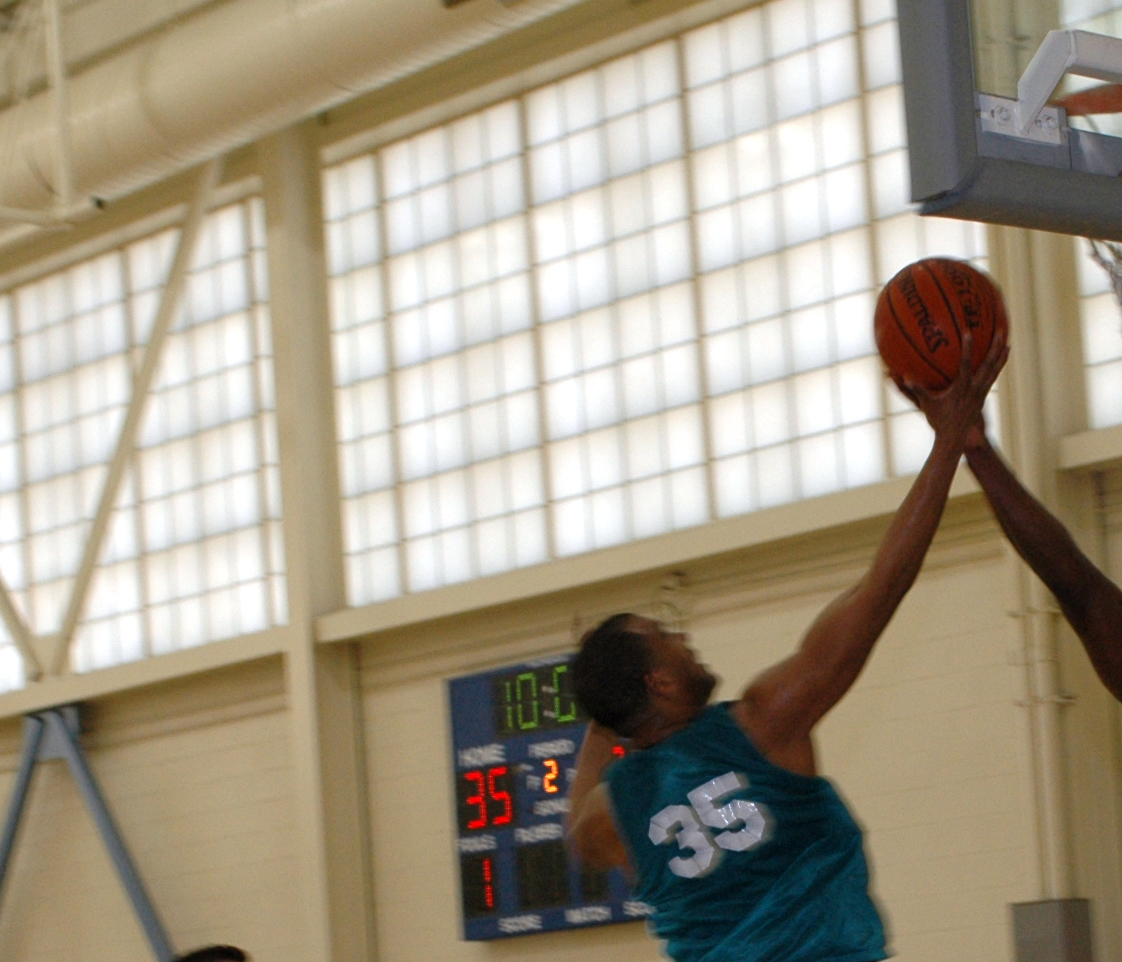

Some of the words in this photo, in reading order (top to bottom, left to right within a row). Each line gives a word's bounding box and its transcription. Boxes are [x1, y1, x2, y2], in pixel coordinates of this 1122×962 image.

[900, 268, 950, 354] SPALDIN
[464, 765, 514, 829] 35
[542, 758, 559, 793] 2
[648, 771, 774, 879] 35
[483, 857, 494, 909] 1
